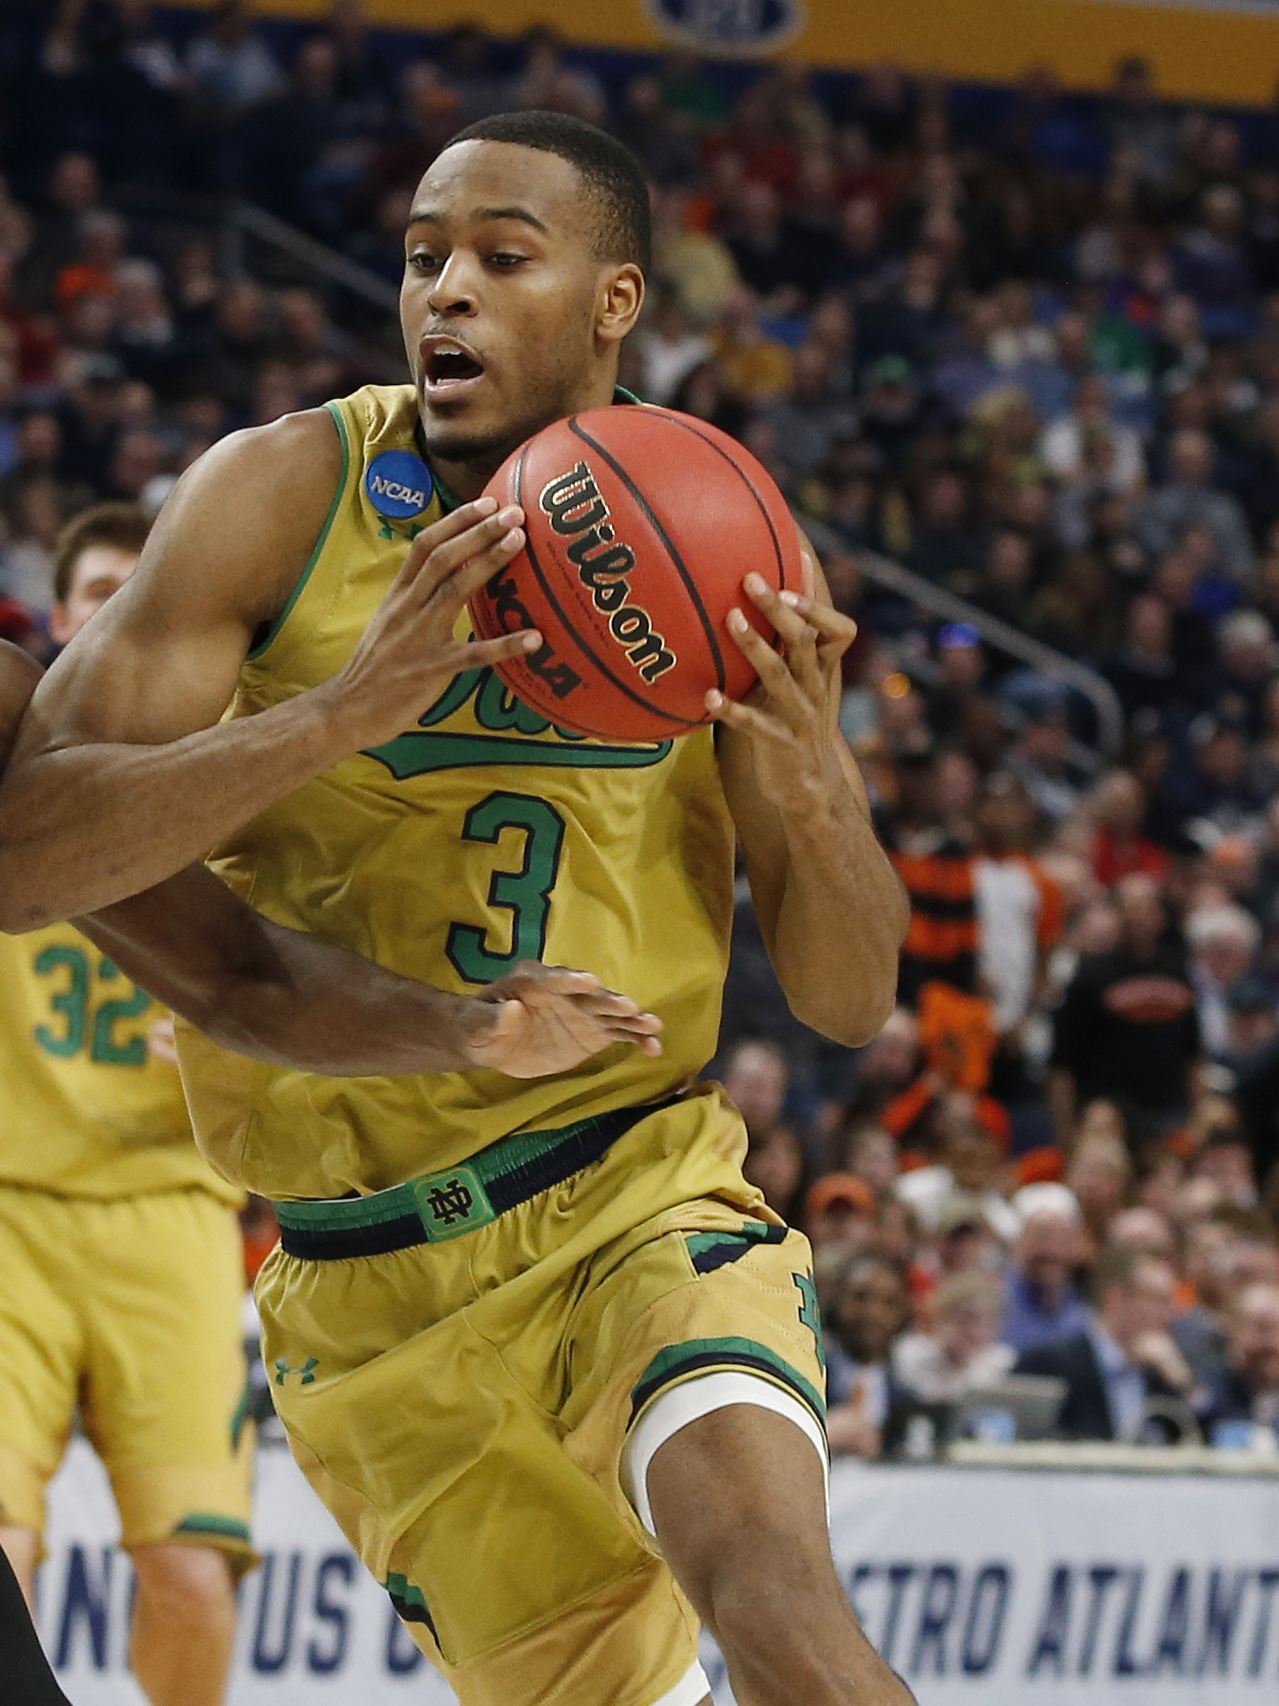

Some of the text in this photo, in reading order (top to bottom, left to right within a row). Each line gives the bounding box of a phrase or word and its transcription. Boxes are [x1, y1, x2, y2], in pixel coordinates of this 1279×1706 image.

[370, 475, 426, 508] NCAA
[539, 461, 678, 686] Wilson
[445, 790, 566, 985] 3
[34, 945, 151, 1067] 32
